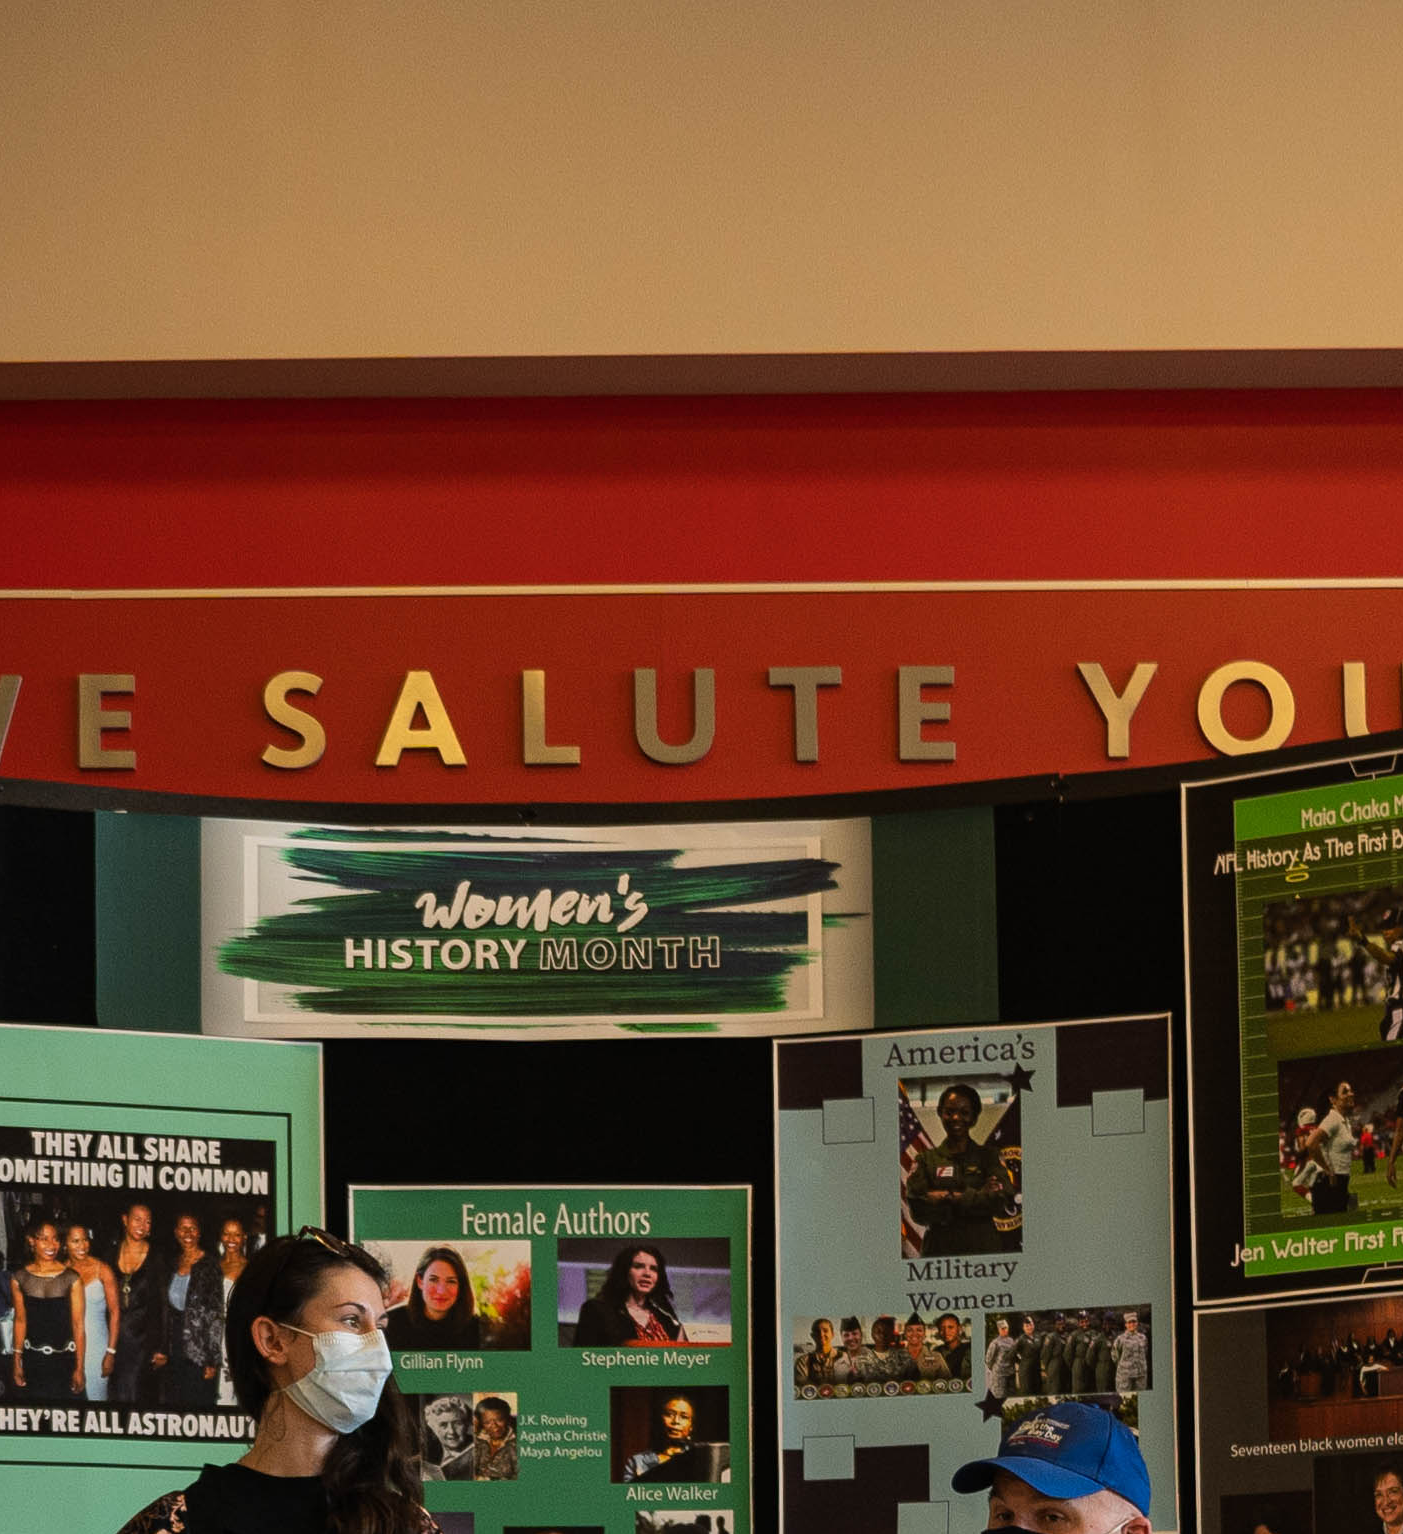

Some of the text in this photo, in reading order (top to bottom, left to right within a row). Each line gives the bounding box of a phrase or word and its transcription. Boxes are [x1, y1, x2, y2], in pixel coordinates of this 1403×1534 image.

[260, 667, 957, 770] SALUTE
[1301, 806, 1336, 829] Maia
[1340, 799, 1390, 823] Chaka
[1247, 847, 1298, 869] History
[1303, 841, 1321, 861] As
[1325, 836, 1354, 858] The
[1357, 833, 1386, 854] First
[415, 872, 649, 933] Women's
[344, 937, 721, 971] HISTORY MONTH
[883, 1034, 1036, 1068] America's
[31, 1131, 221, 1165] THEY ALL SHARE
[128, 1164, 153, 1190] IN
[159, 1167, 269, 1195] COMMON
[462, 1201, 651, 1235] Female Authors
[1230, 1243, 1264, 1267] Jen
[1271, 1238, 1338, 1260] Walter
[1344, 1230, 1386, 1252] First
[906, 1258, 1018, 1283] Military
[906, 1291, 1015, 1313] Women
[400, 1353, 483, 1373] Gillian Flynn
[582, 1351, 711, 1368] Stephenie Meyer
[84, 1410, 124, 1434] ALL
[541, 1415, 587, 1429] Rowling
[520, 1429, 608, 1444] Agatha Christie
[1230, 1440, 1297, 1458] Seventeen
[1300, 1437, 1333, 1452] black
[1336, 1435, 1384, 1449] women
[520, 1446, 603, 1460] Maya Angelou
[626, 1486, 718, 1501] Alice Walker
